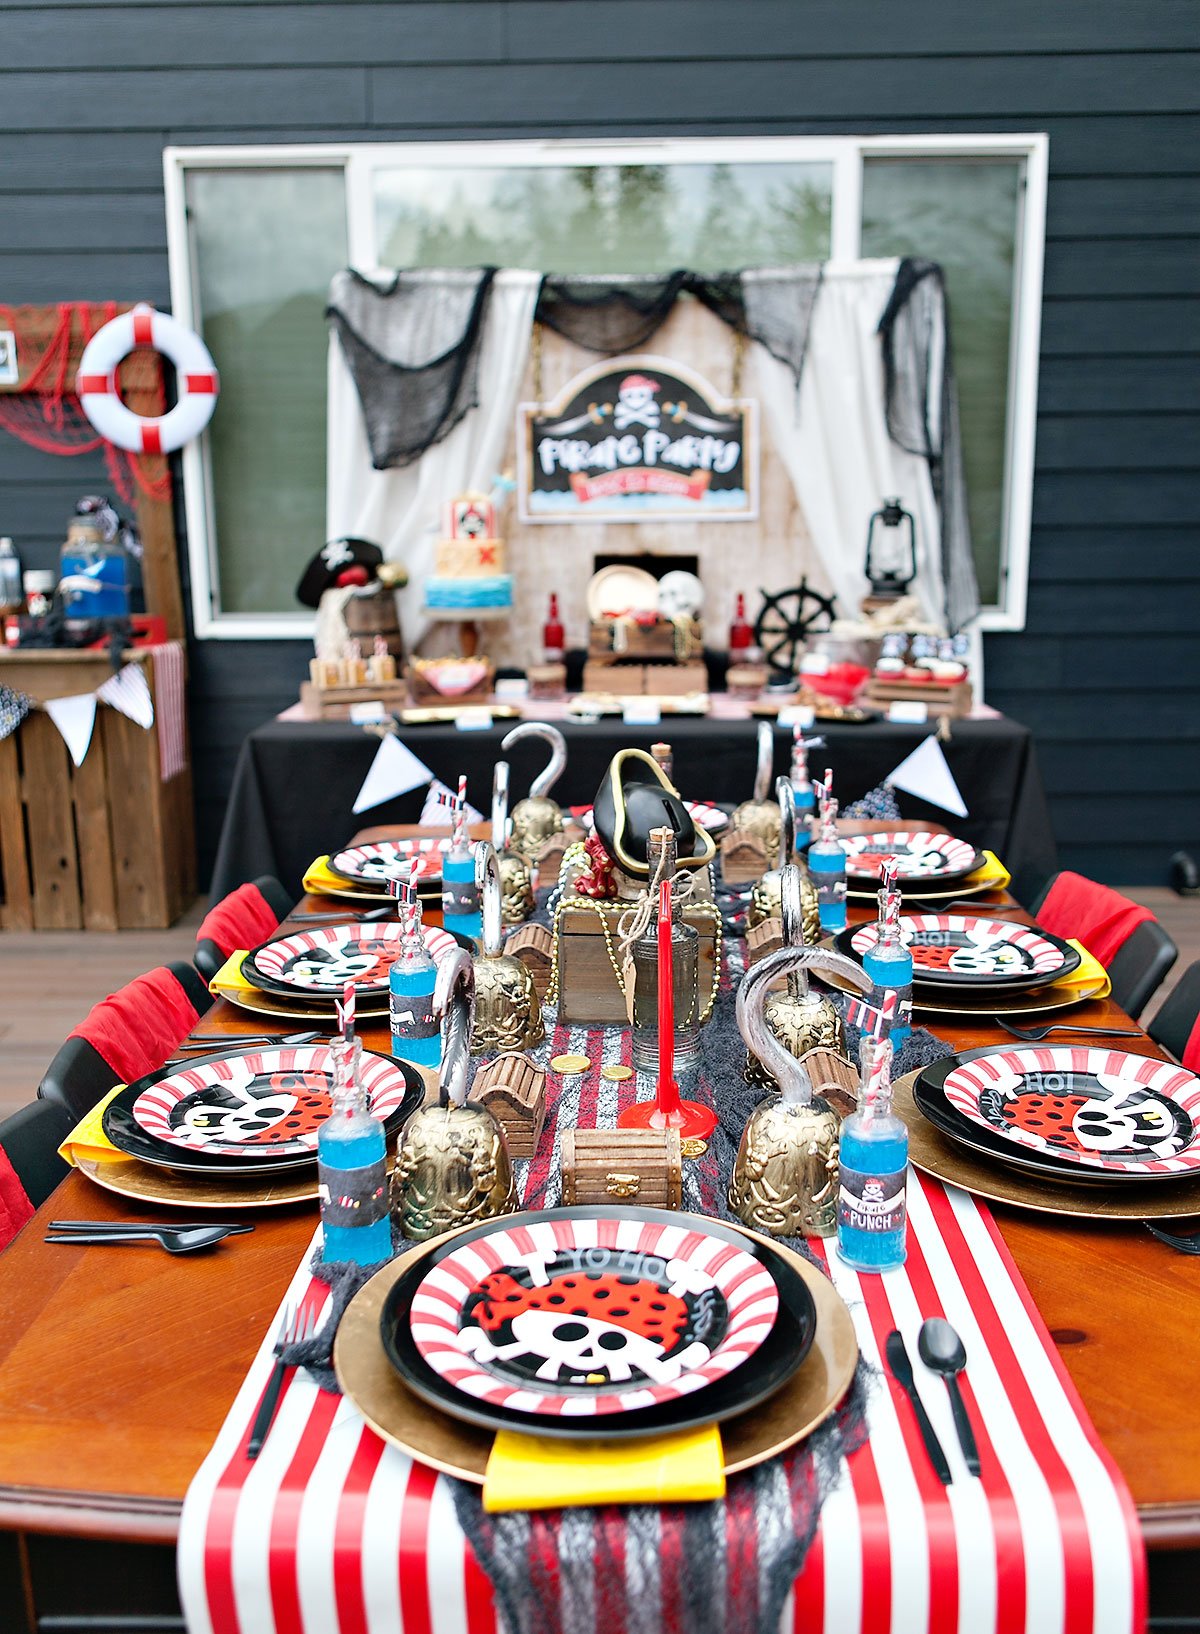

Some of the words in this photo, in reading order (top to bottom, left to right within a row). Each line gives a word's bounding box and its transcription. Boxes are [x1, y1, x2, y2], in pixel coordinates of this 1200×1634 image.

[1024, 1072, 1074, 1094] HO!
[850, 1209, 892, 1230] PUNCH
[560, 1247, 611, 1271] YO
[617, 1248, 667, 1280] HO
